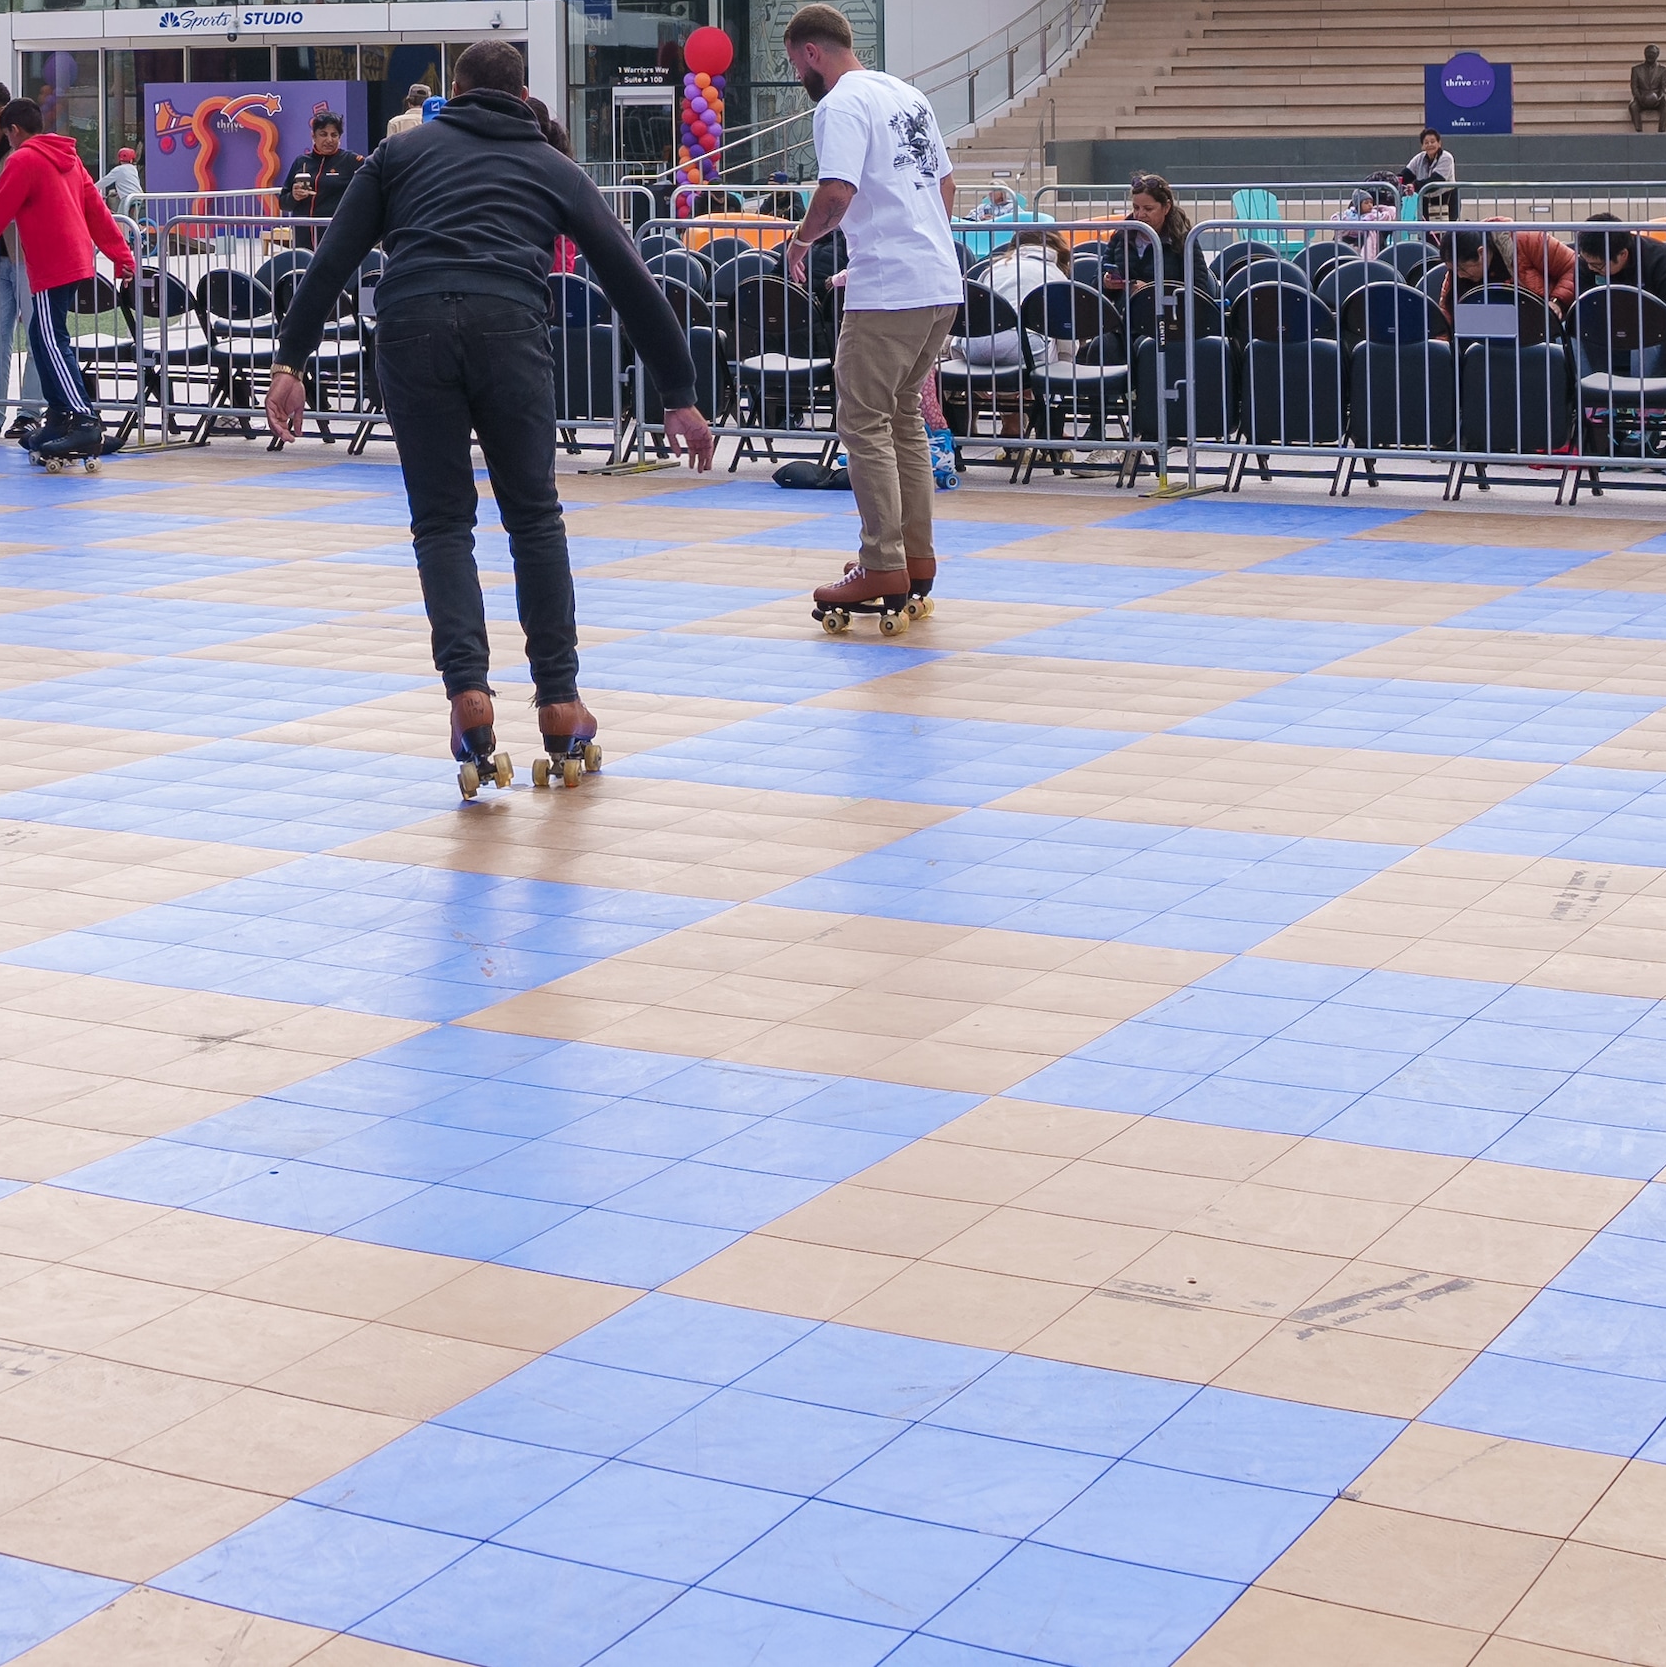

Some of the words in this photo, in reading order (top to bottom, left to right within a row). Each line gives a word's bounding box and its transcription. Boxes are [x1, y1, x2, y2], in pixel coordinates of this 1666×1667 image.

[179, 10, 232, 31] Sports
[243, 12, 304, 25] STUDIO
[623, 66, 654, 74] Warriors
[655, 66, 670, 75] Way
[624, 75, 643, 83] Suite
[650, 76, 664, 84] 100
[1445, 76, 1472, 87] thrive
[1473, 79, 1491, 87] CITY
